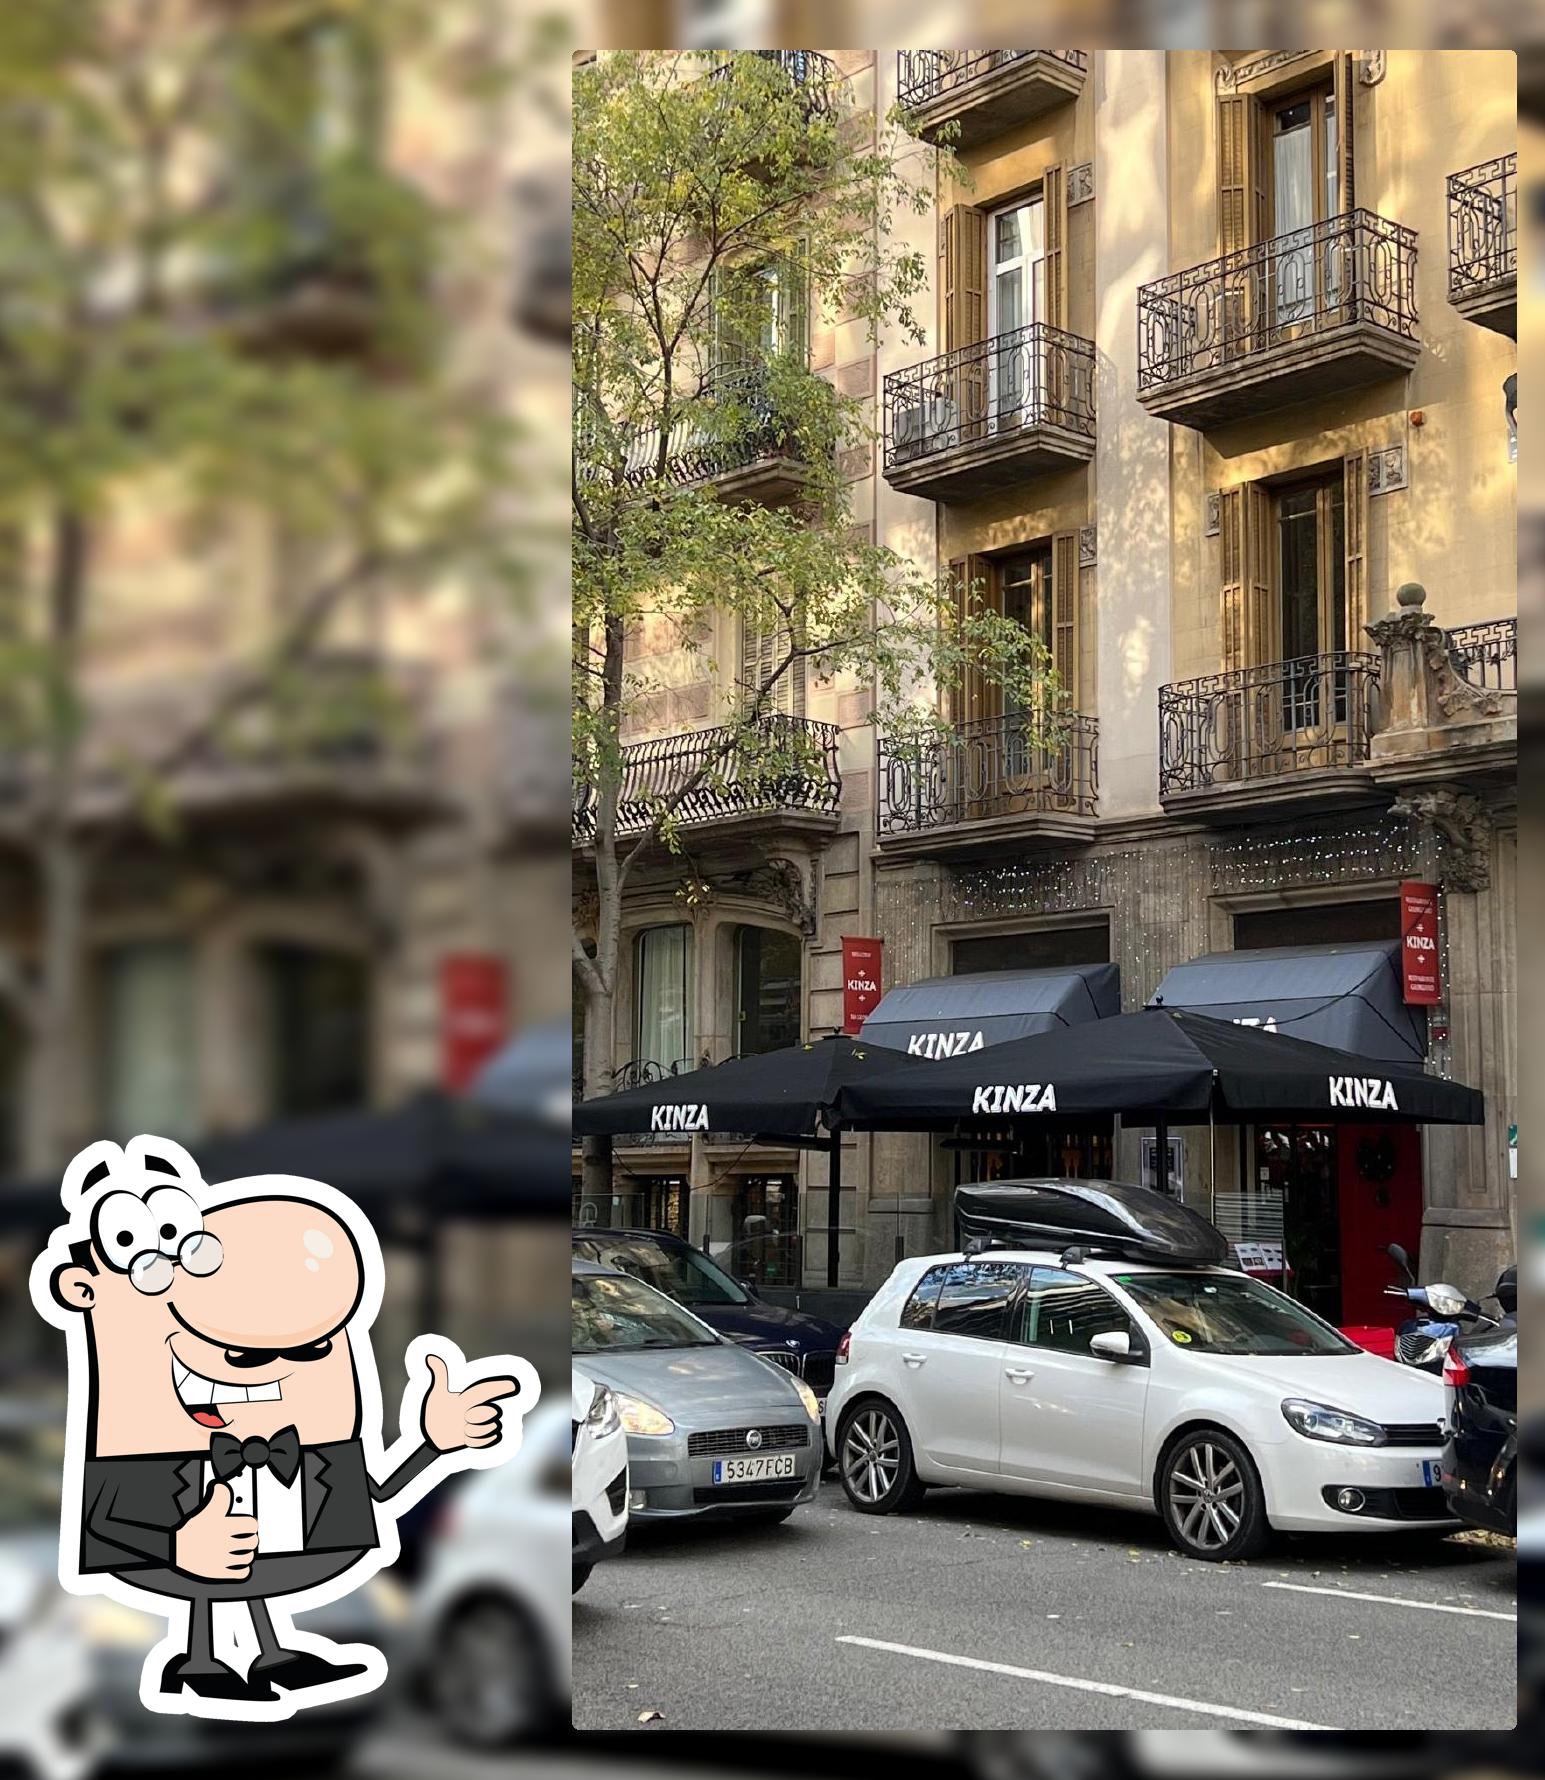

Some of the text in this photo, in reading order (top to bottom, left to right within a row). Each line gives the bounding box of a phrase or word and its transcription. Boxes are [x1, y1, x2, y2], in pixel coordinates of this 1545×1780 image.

[1406, 936, 1435, 950] KINZA
[847, 980, 877, 992] KINZA
[907, 1031, 985, 1061] KINZA
[972, 1083, 1057, 1114] KINZA
[1329, 1076, 1399, 1110] KINZA
[651, 1104, 709, 1131] KINZA
